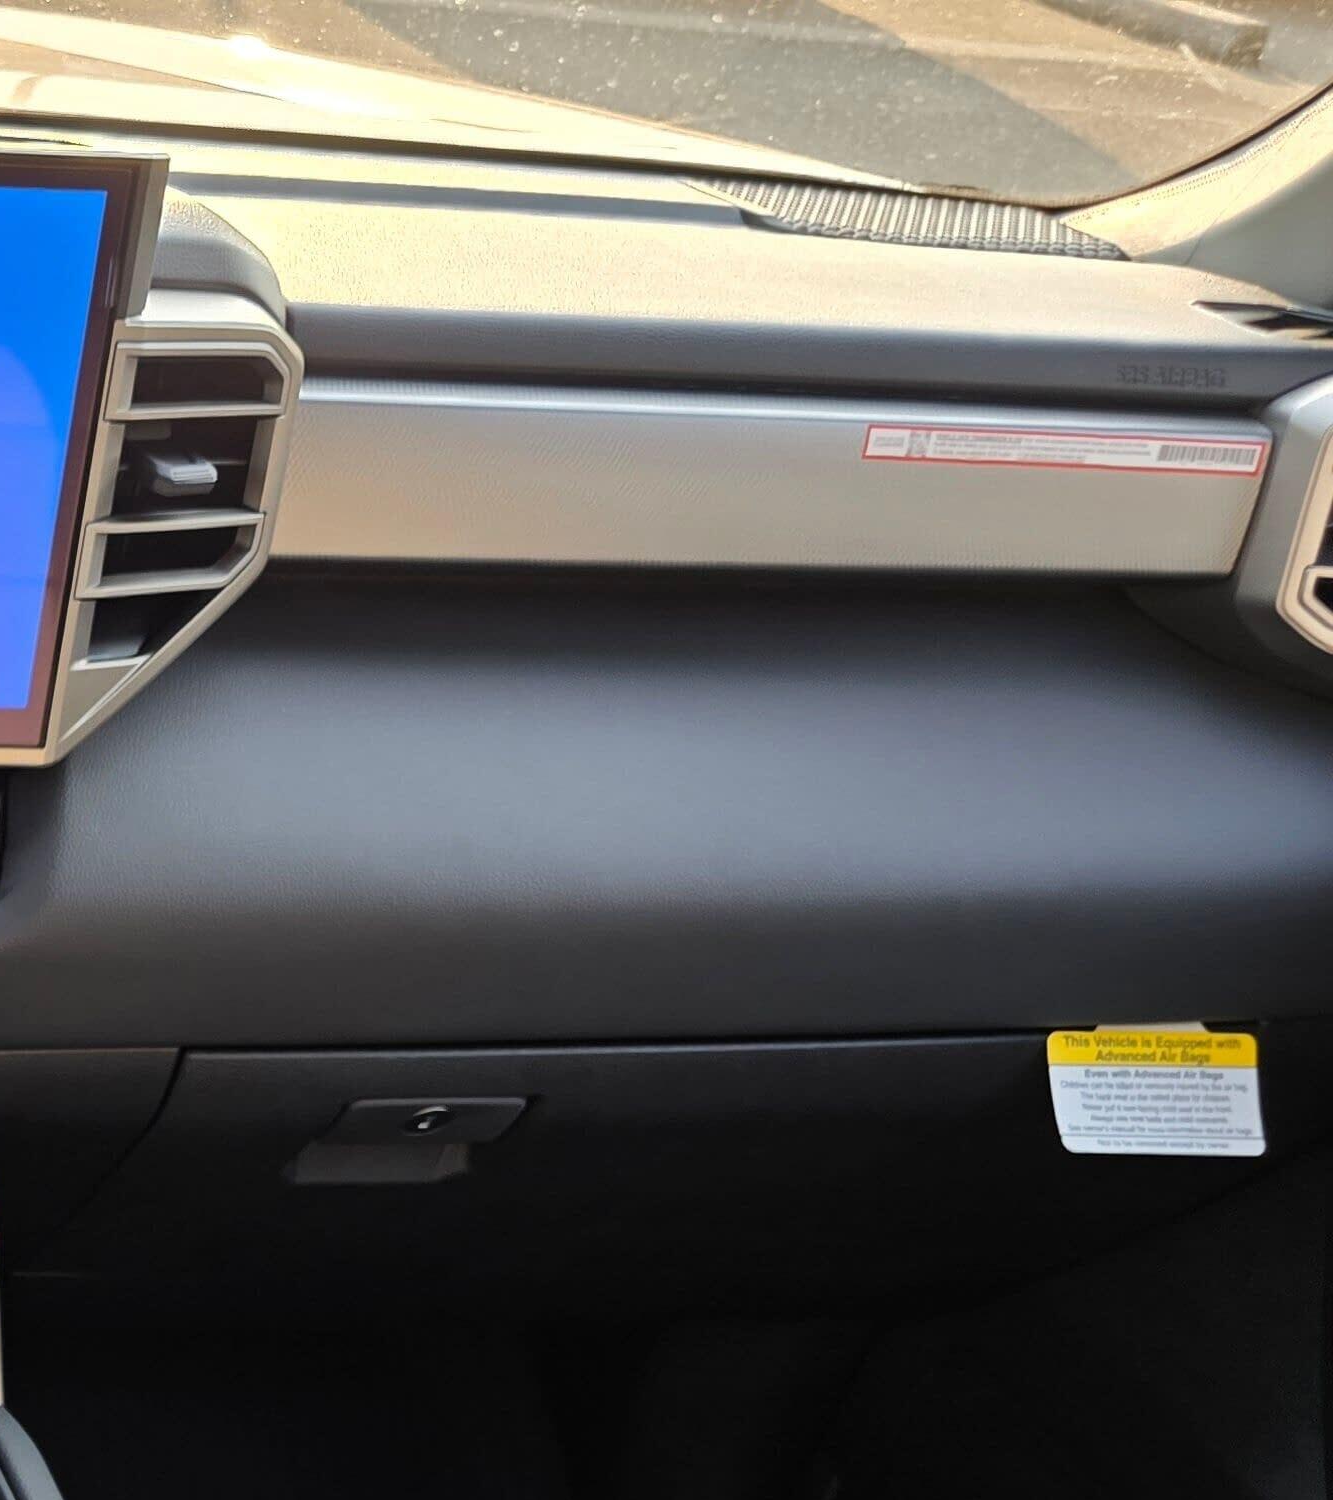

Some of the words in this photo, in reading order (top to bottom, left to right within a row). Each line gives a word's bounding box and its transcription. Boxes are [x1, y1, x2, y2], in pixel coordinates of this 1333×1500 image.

[1063, 1034, 1090, 1049] This
[1093, 1035, 1137, 1049] Vehicle
[1141, 1036, 1152, 1049] is
[1156, 1036, 1212, 1052] Equipped
[1216, 1038, 1241, 1049] with
[1095, 1049, 1155, 1063] Advanced
[1159, 1050, 1177, 1063] Air
[1181, 1051, 1211, 1066] Bags
